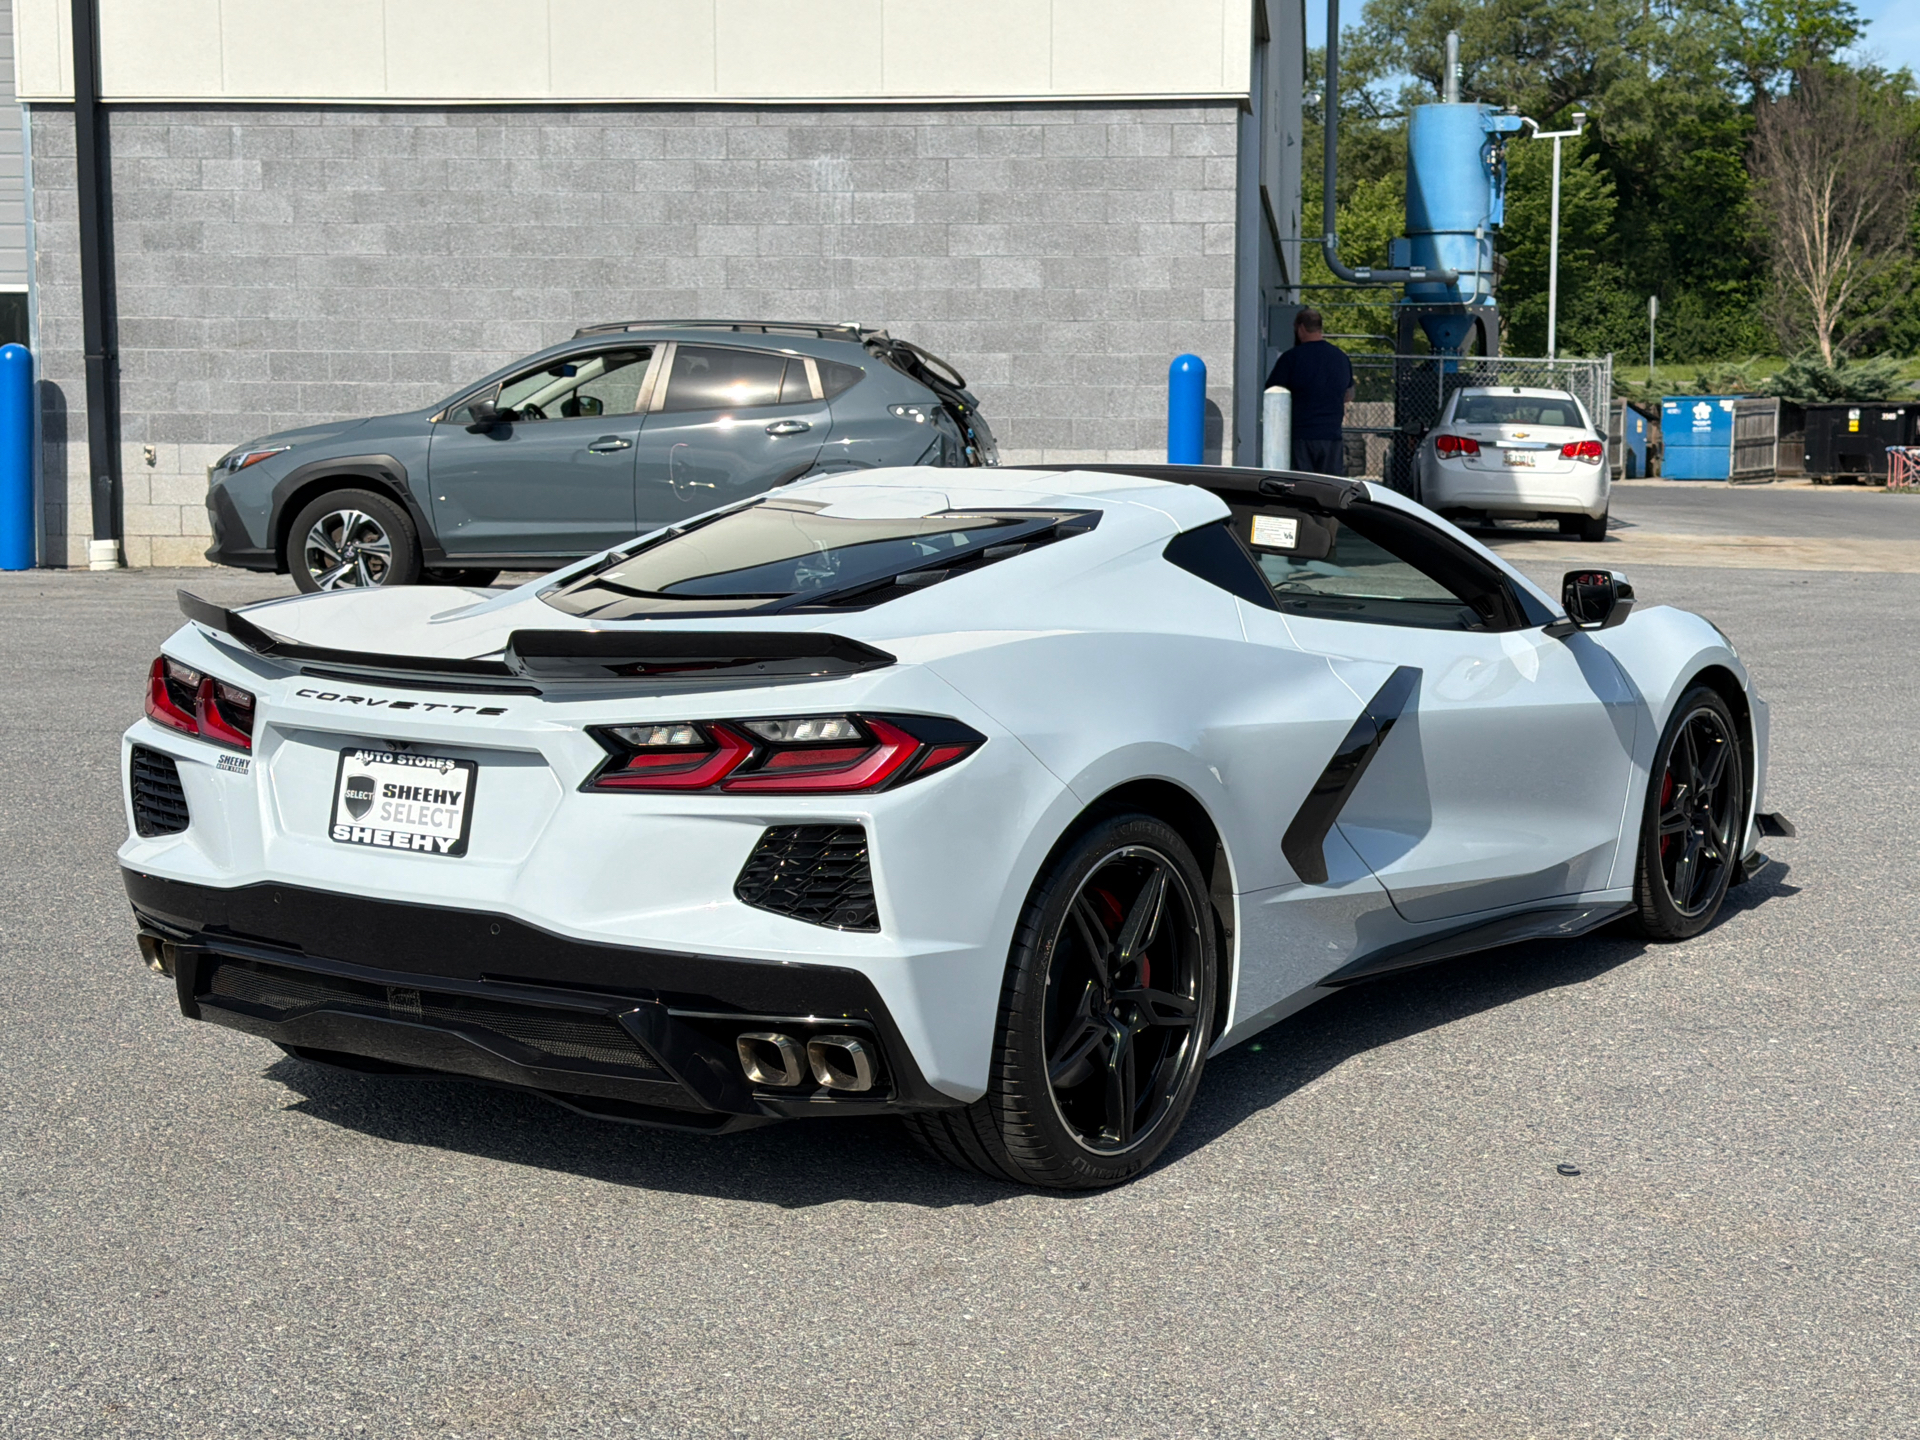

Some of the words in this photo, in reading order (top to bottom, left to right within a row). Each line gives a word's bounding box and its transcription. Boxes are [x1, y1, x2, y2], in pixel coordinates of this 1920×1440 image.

[295, 688, 509, 716] CORVETTE
[217, 754, 251, 769] SHEEHY
[354, 749, 394, 764] AUTO
[397, 754, 456, 770] STORES
[345, 790, 374, 801] SELECT
[382, 783, 462, 806] SHEEHY
[380, 801, 460, 829] SELECT
[332, 825, 458, 854] SHEEHY
